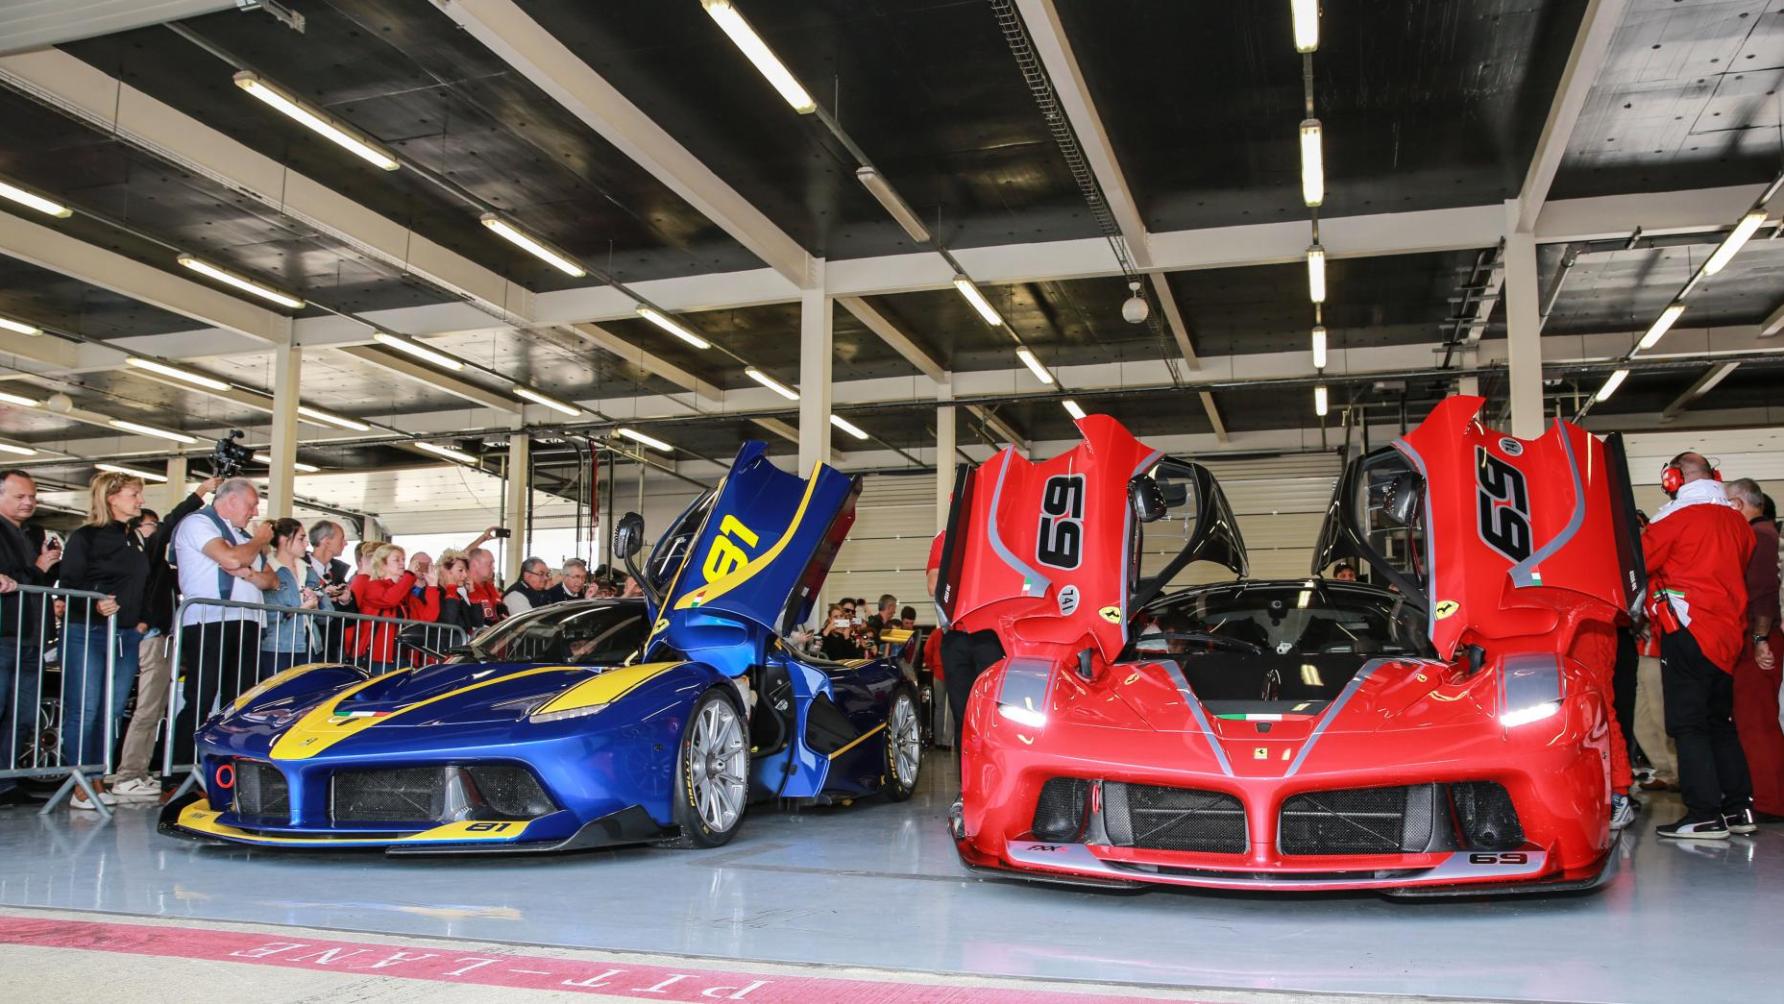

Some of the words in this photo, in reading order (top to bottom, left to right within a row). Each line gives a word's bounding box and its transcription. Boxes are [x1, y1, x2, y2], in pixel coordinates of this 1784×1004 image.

[1036, 473, 1086, 570] 69
[1475, 444, 1533, 565] 69
[702, 514, 760, 583] 81
[465, 822, 512, 832] 81
[1468, 853, 1528, 865] 69
